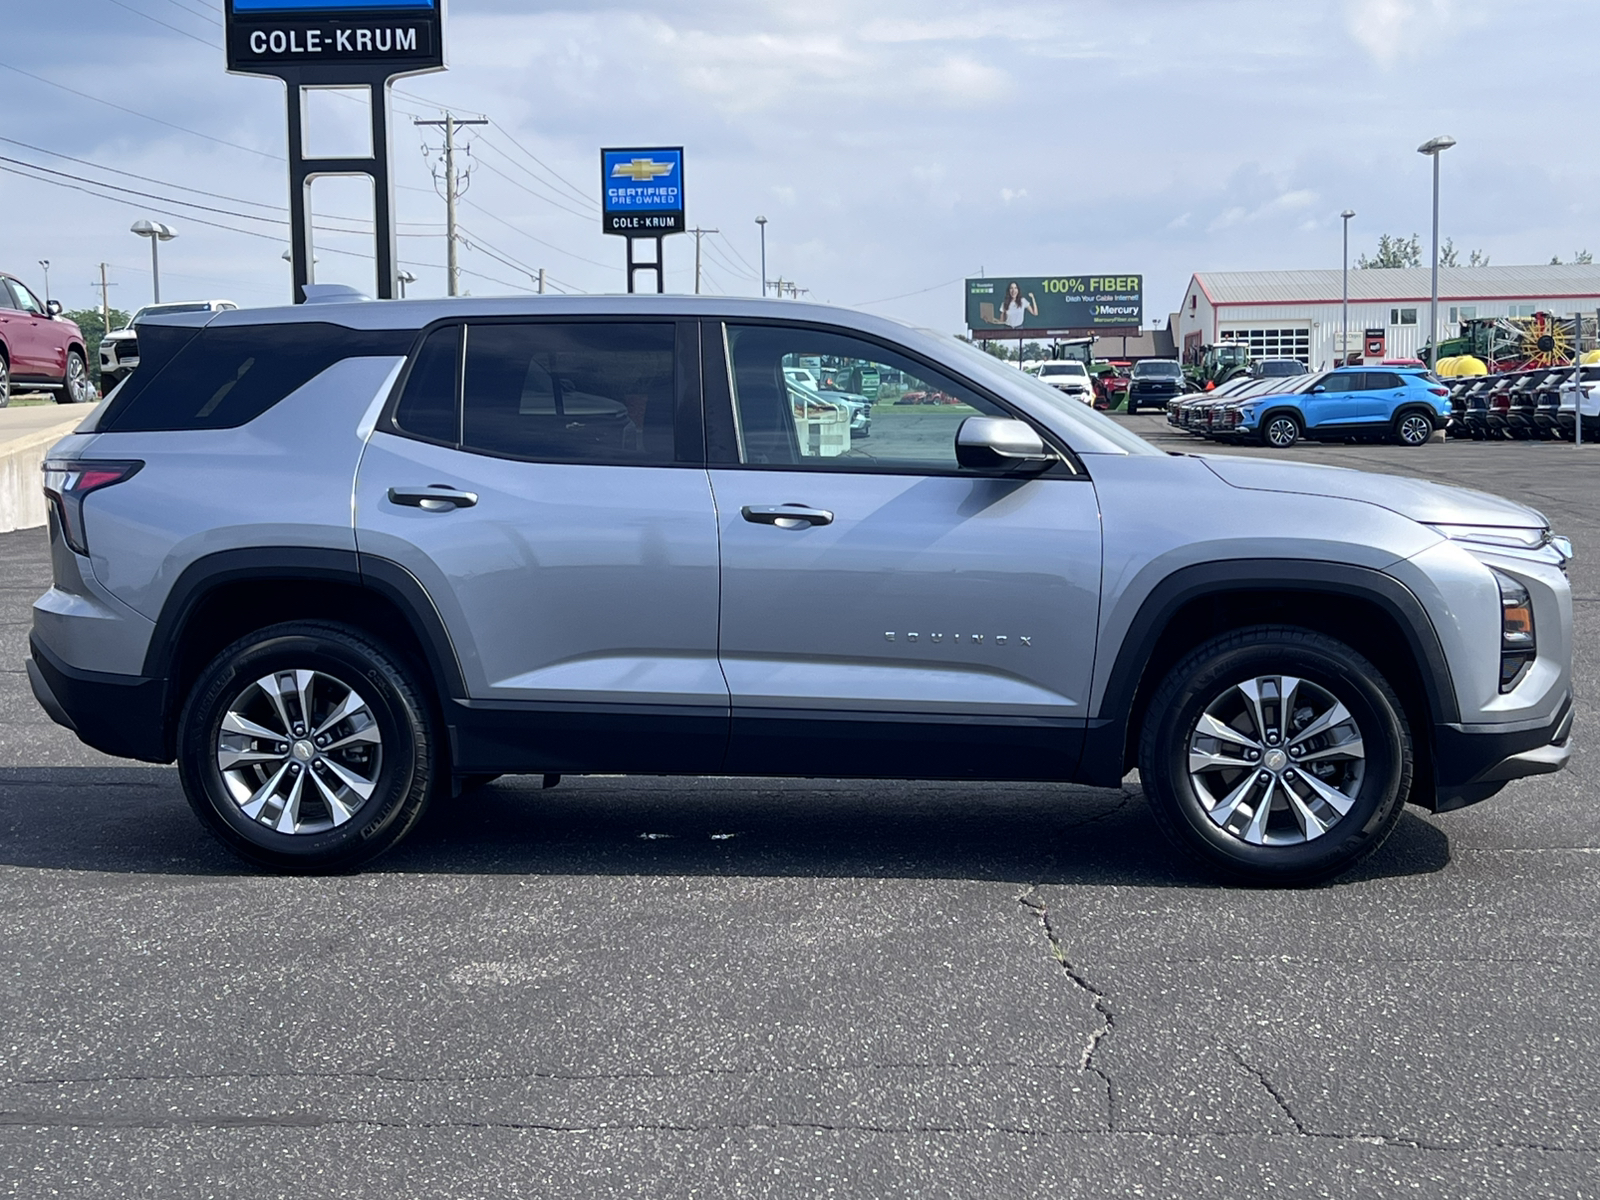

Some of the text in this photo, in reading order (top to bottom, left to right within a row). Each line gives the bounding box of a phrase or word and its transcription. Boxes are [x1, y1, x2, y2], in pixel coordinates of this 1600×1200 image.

[249, 27, 417, 54] COLE-KRUM
[608, 186, 678, 197] CERTIFIED
[612, 195, 675, 205] PRE-OWNED
[612, 217, 675, 228] COLE-KRUM
[1041, 277, 1139, 293] 100% FIBER
[1065, 295, 1081, 303] Ditch
[1095, 294, 1114, 302] Cable
[1100, 304, 1139, 316] Mercury
[884, 631, 1032, 647] EQUINOX
